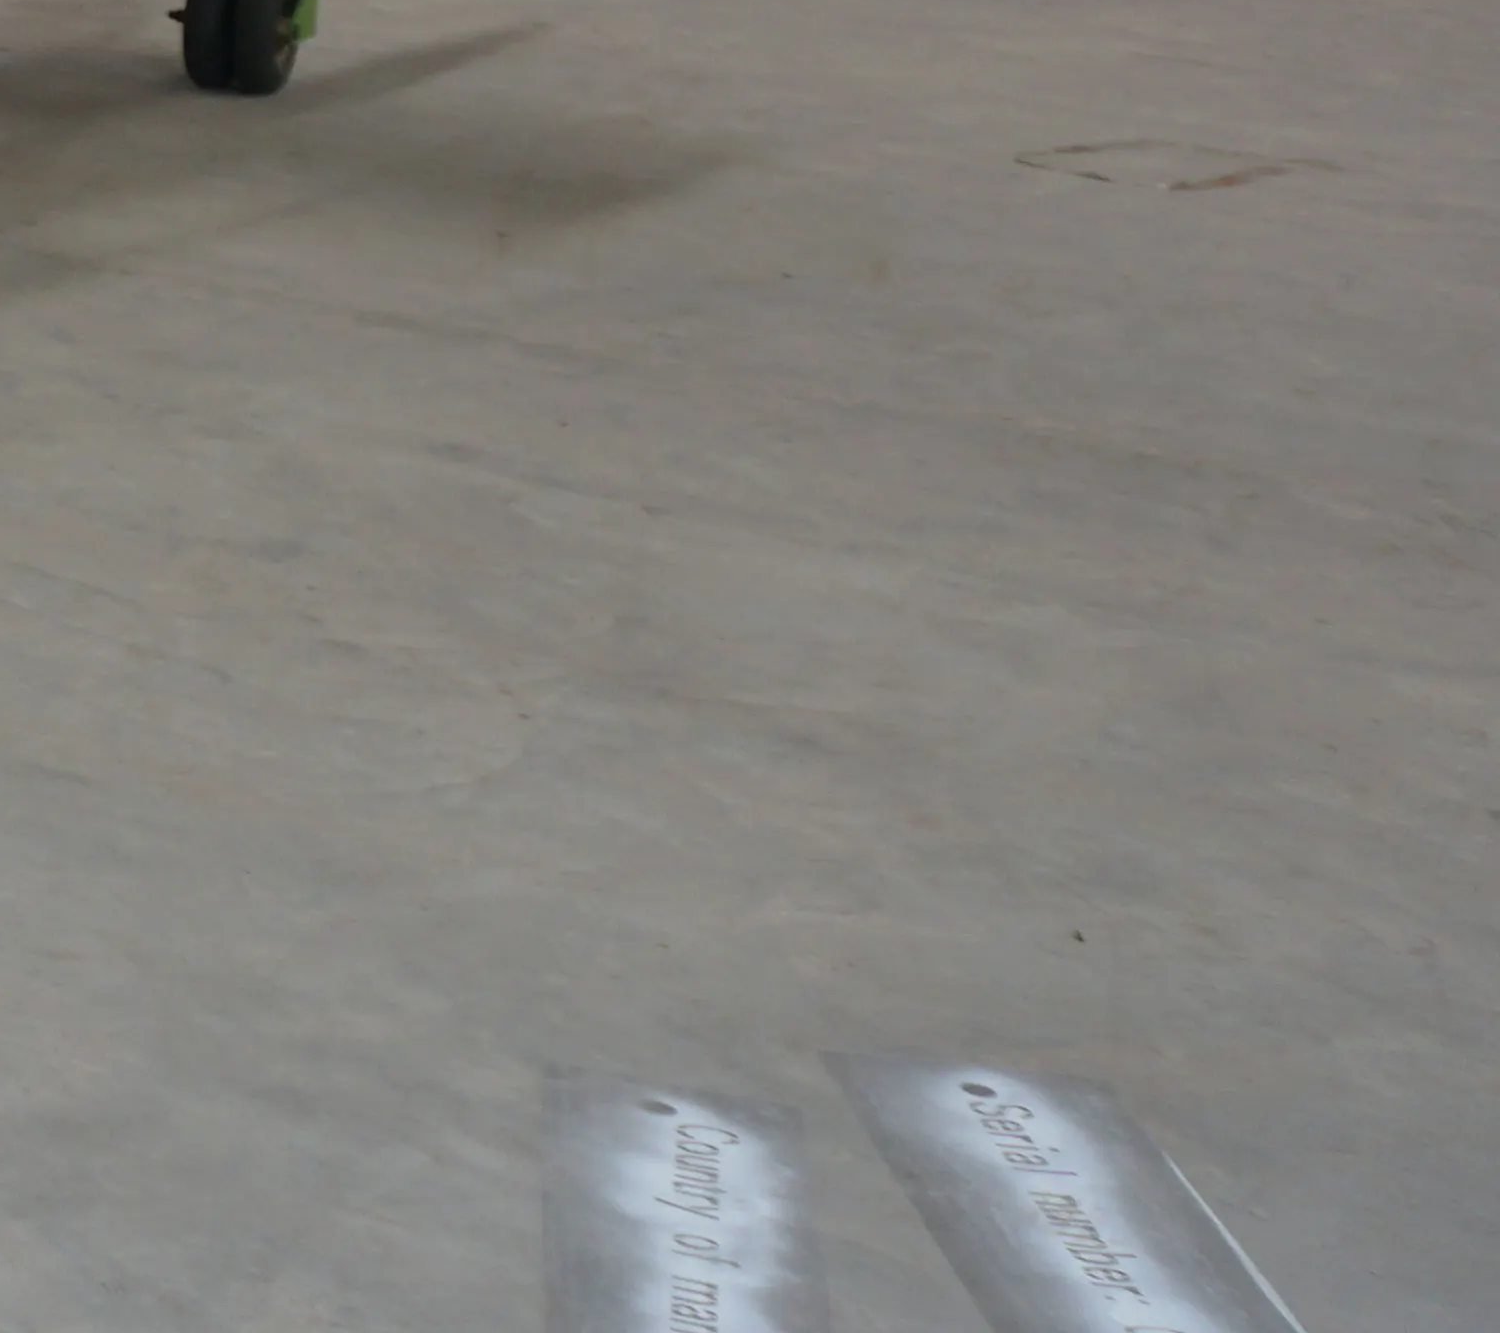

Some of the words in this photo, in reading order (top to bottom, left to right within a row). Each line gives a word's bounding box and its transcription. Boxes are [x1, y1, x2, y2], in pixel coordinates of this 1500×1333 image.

[654, 1124, 741, 1221] Country
[968, 1101, 1079, 1176] Serial
[1028, 1190, 1151, 1305] number:
[671, 1233, 741, 1268] of
